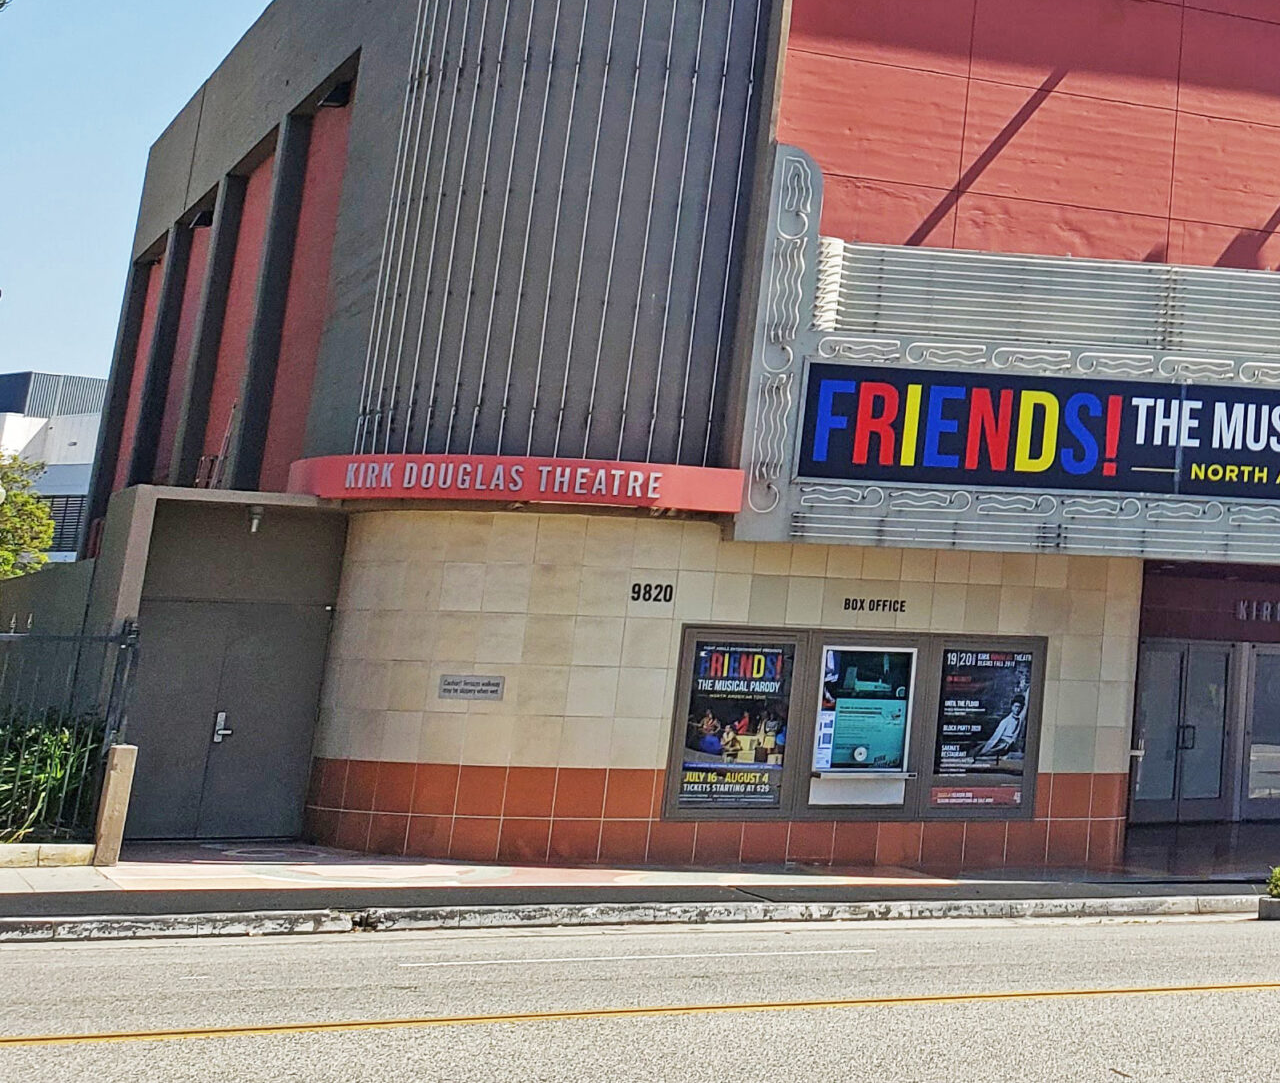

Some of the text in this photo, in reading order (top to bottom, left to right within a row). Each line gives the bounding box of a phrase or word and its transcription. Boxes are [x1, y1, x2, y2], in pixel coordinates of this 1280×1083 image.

[812, 378, 1123, 477] FRIENDS!
[1131, 396, 1202, 449] THE
[345, 462, 663, 499] KIRK DOUGLAS THEATRE
[1190, 462, 1269, 485] NORTH
[631, 582, 673, 603] 9820
[843, 598, 906, 613] BOX OFFICE
[699, 651, 782, 680] FRIENDS!
[698, 679, 780, 693] THE MUSICAL PARODY
[683, 783, 710, 792] TICKETS
[712, 784, 745, 793] STARTING
[746, 784, 755, 792] AT
[684, 772, 706, 783] JULY
[707, 772, 717, 783] 16
[725, 772, 761, 784] AUGUST
[762, 773, 769, 784] 4
